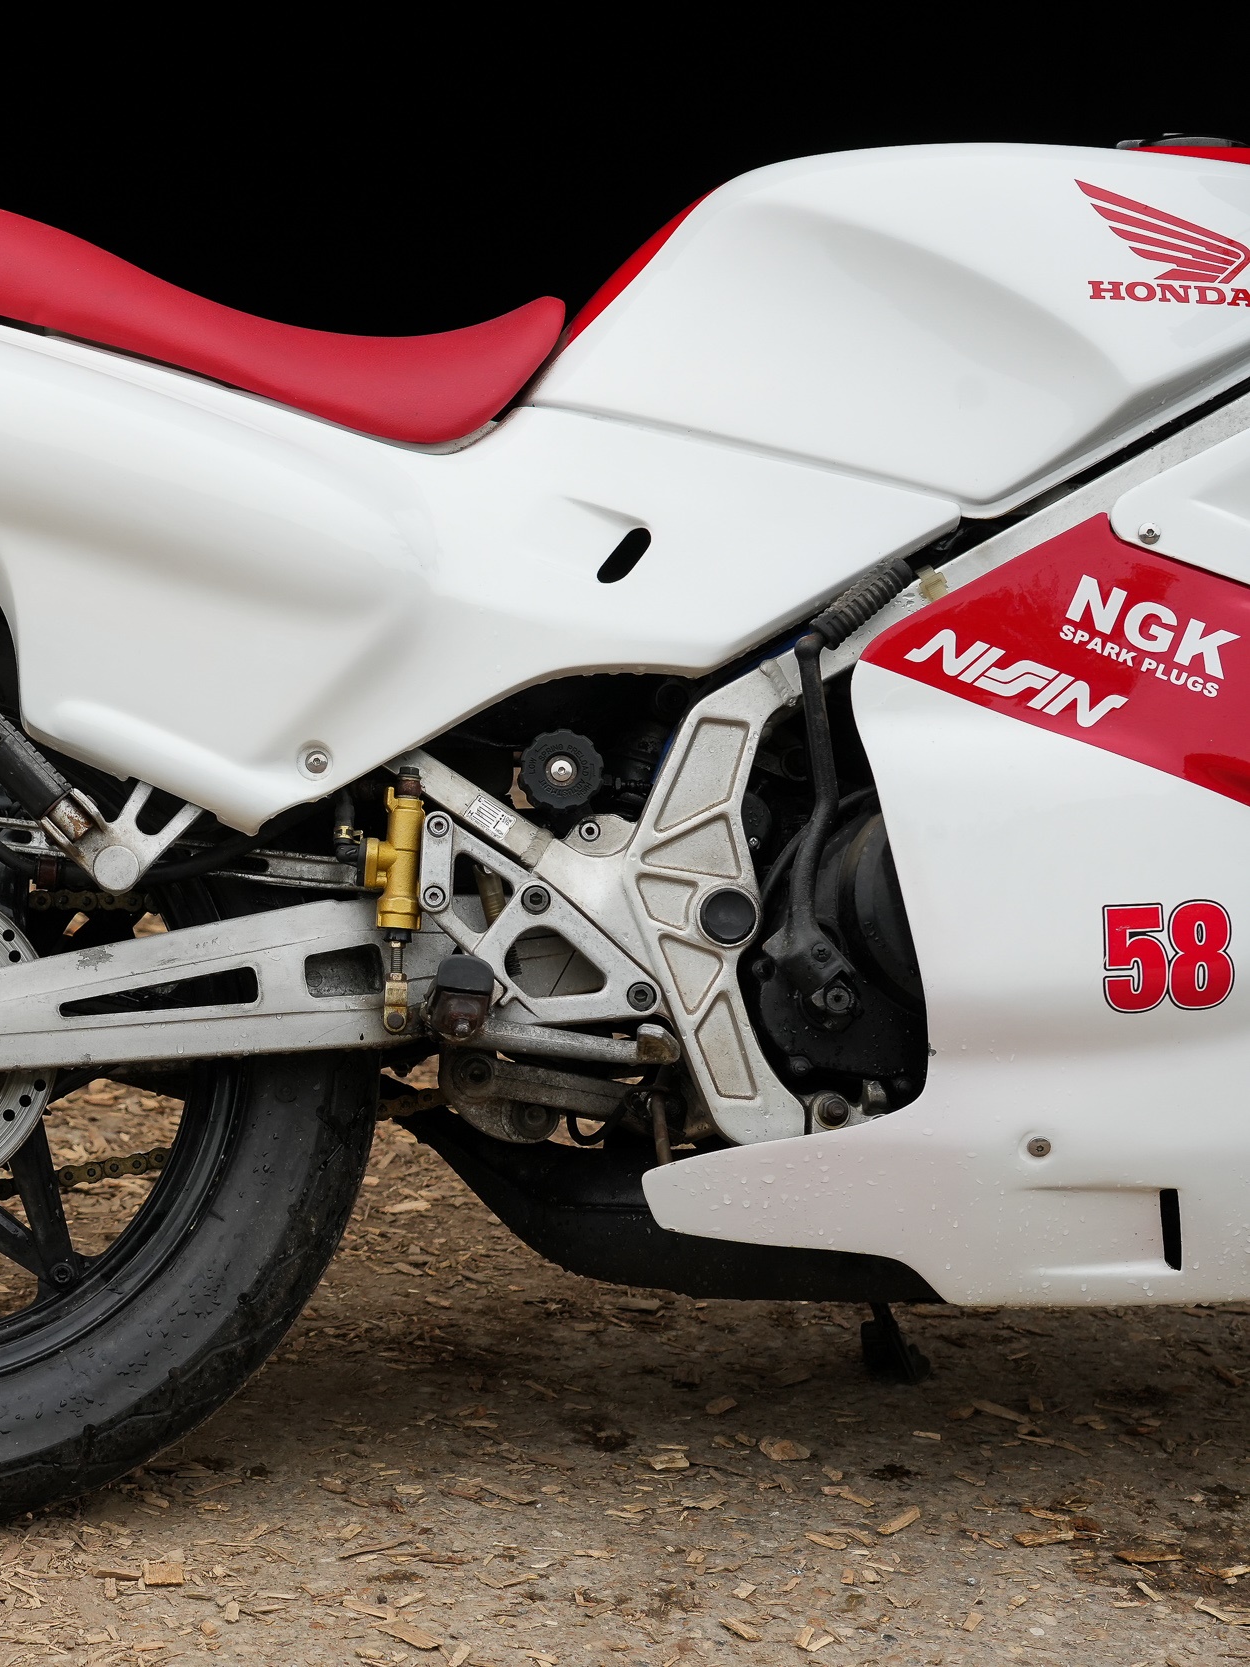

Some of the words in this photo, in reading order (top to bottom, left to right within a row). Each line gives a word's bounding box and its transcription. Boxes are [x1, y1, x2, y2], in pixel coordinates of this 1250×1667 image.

[1088, 281, 1250, 307] HONDA
[1059, 624, 1138, 667] SPARK
[1141, 657, 1219, 698] PLUGS
[1065, 574, 1241, 680] NGK
[903, 629, 1129, 728] NISSIN
[529, 757, 537, 775] LOW
[538, 744, 564, 761] SPRING
[567, 744, 589, 777] PRELOAD
[1102, 899, 1235, 1014] 58
